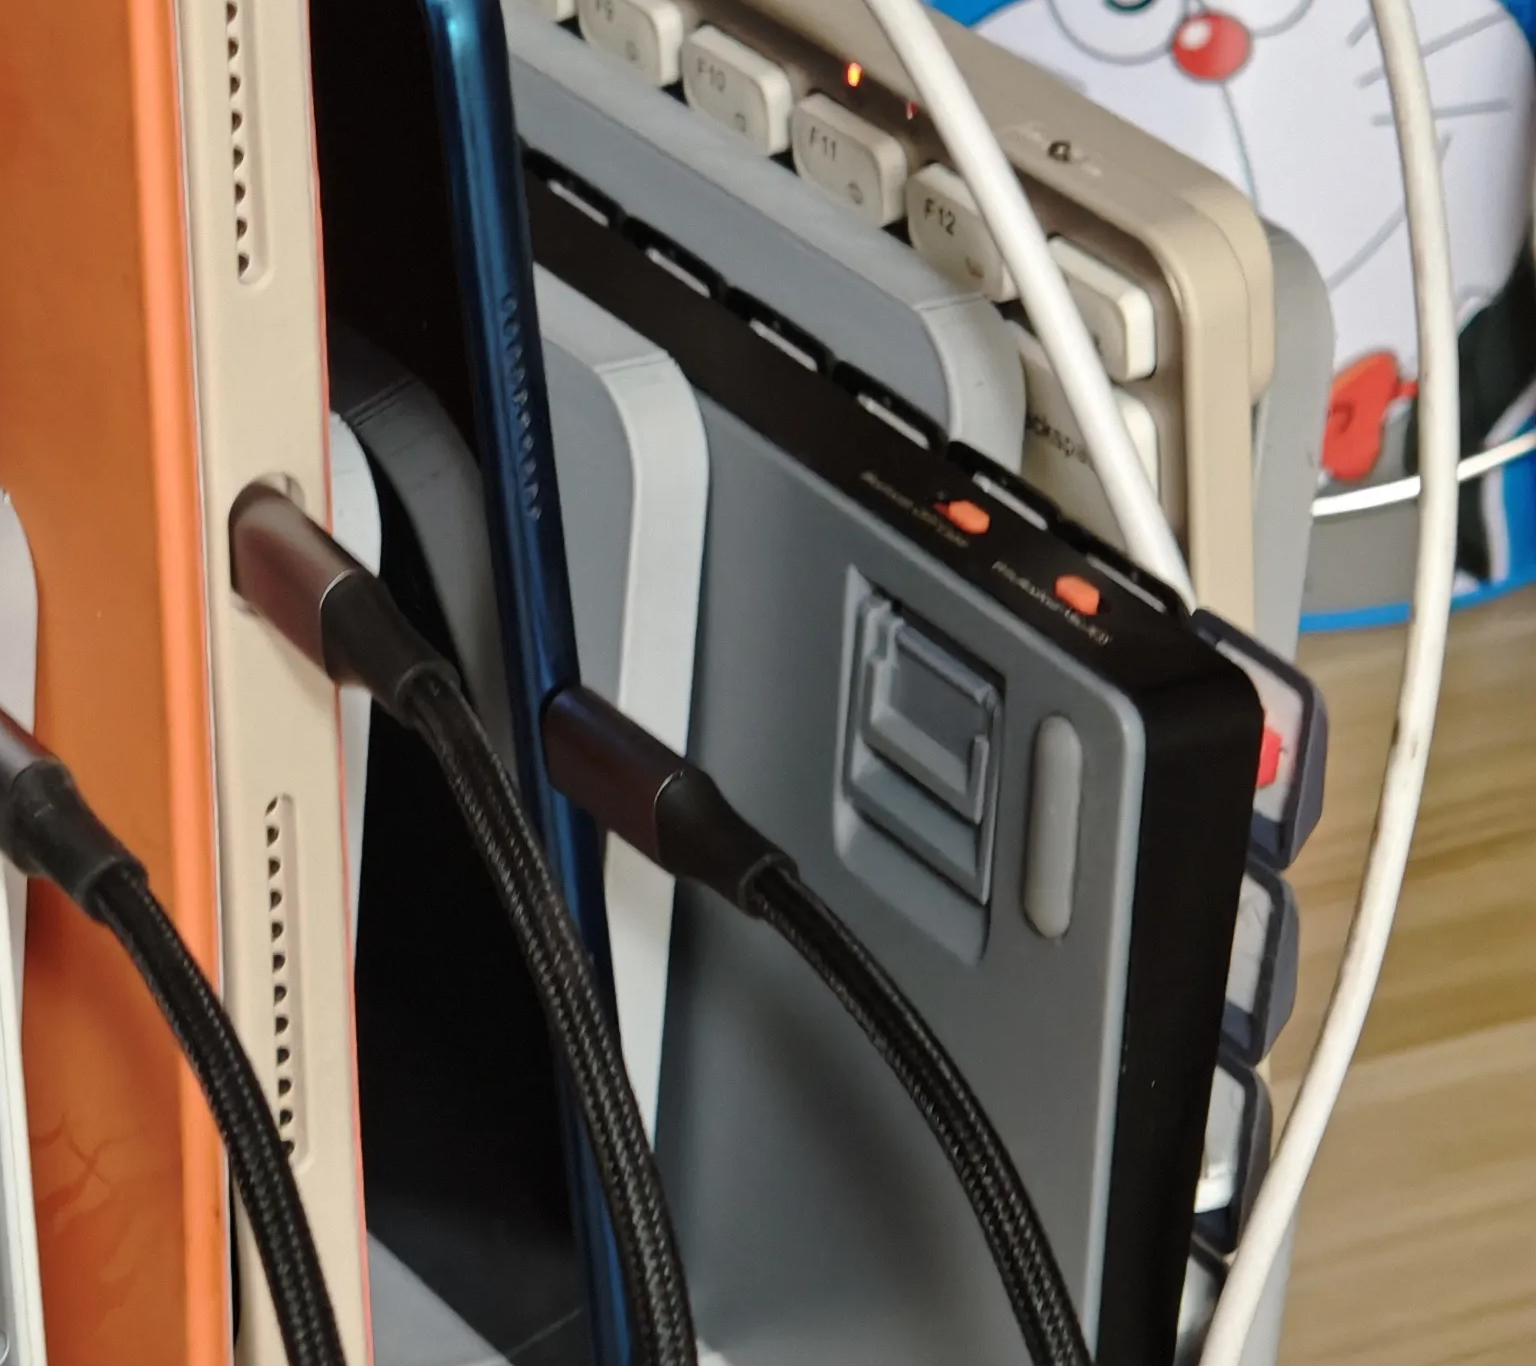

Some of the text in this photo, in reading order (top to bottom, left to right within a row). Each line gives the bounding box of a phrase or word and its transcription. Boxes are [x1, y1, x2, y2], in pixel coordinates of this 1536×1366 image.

[696, 56, 726, 92] F10
[808, 126, 837, 161] F11
[923, 197, 957, 236] F12
